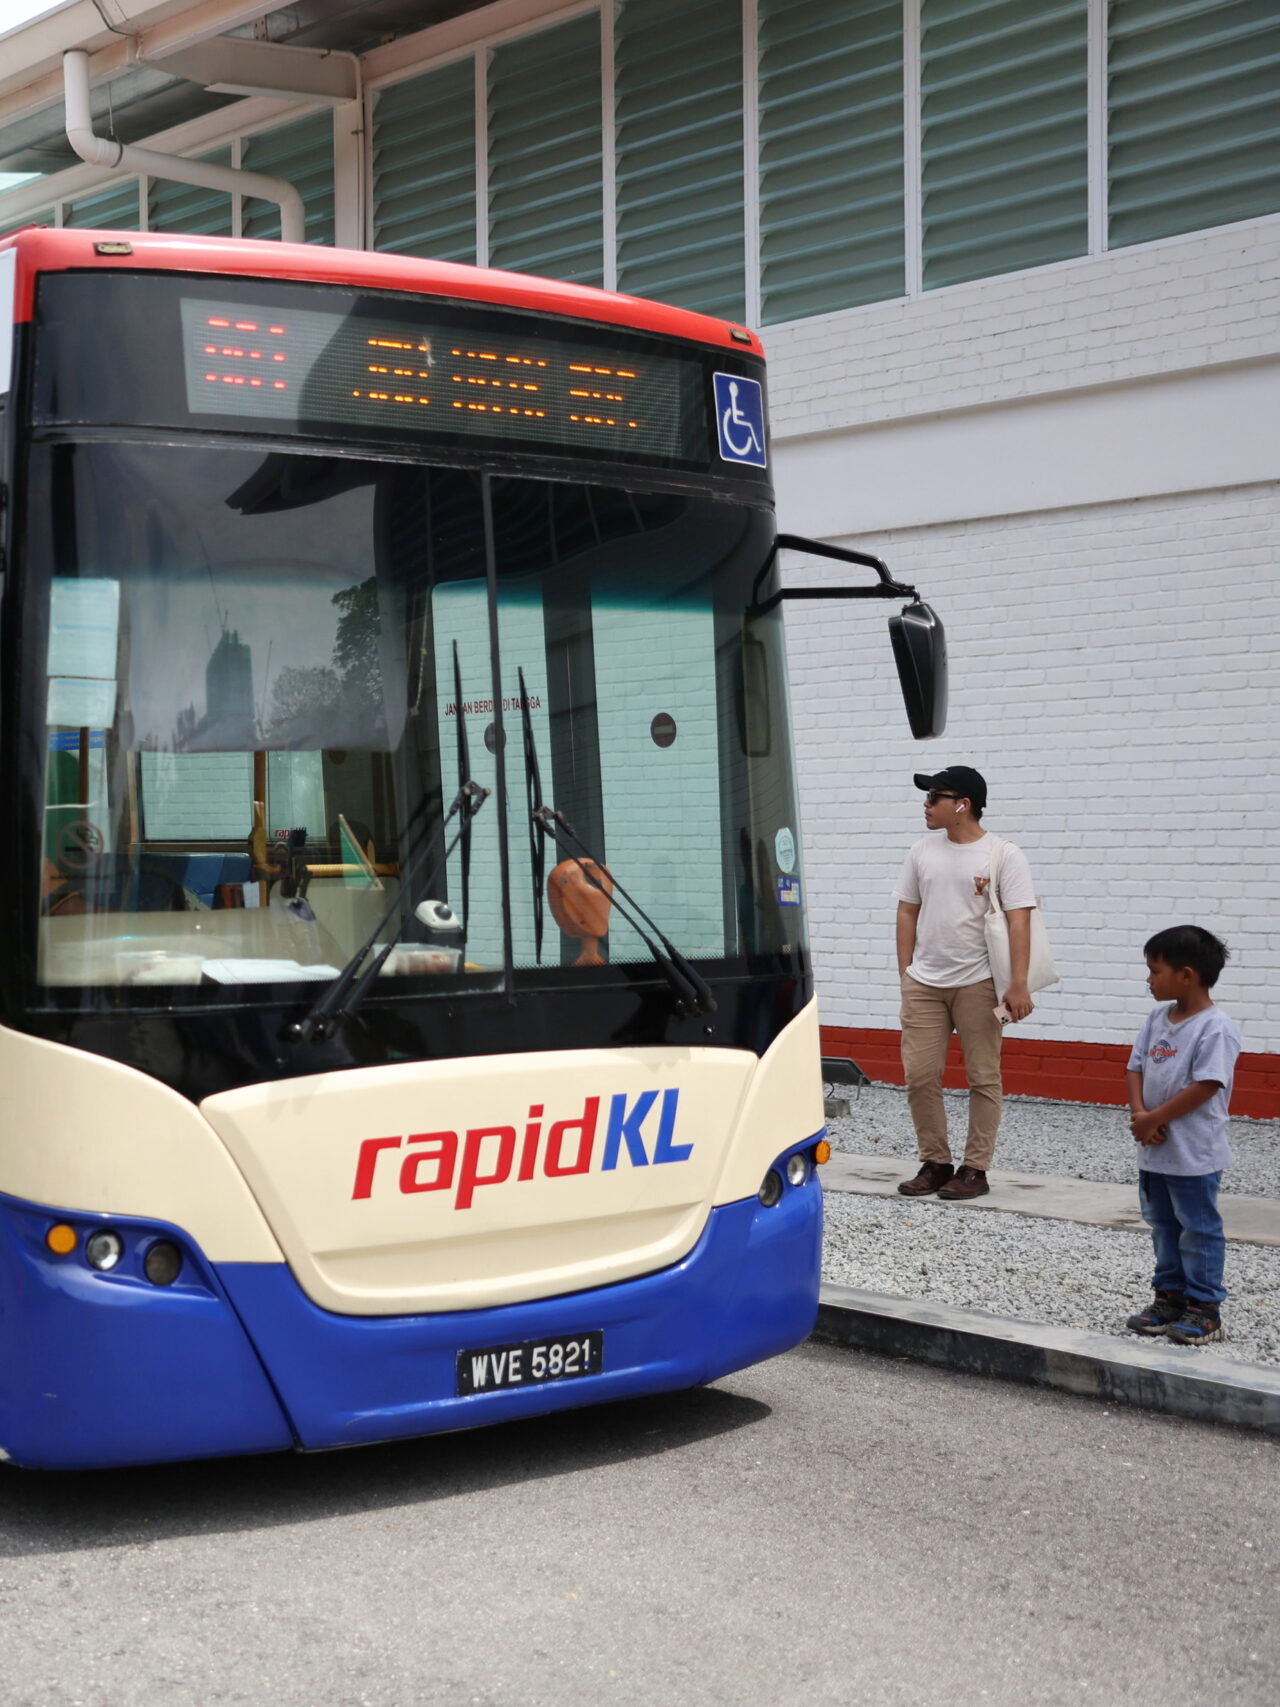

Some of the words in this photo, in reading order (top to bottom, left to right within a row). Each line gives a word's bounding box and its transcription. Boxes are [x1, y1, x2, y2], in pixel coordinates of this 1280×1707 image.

[445, 701, 472, 716] JANAN
[471, 1349, 523, 1389] WVE
[531, 1338, 591, 1379] 5821
